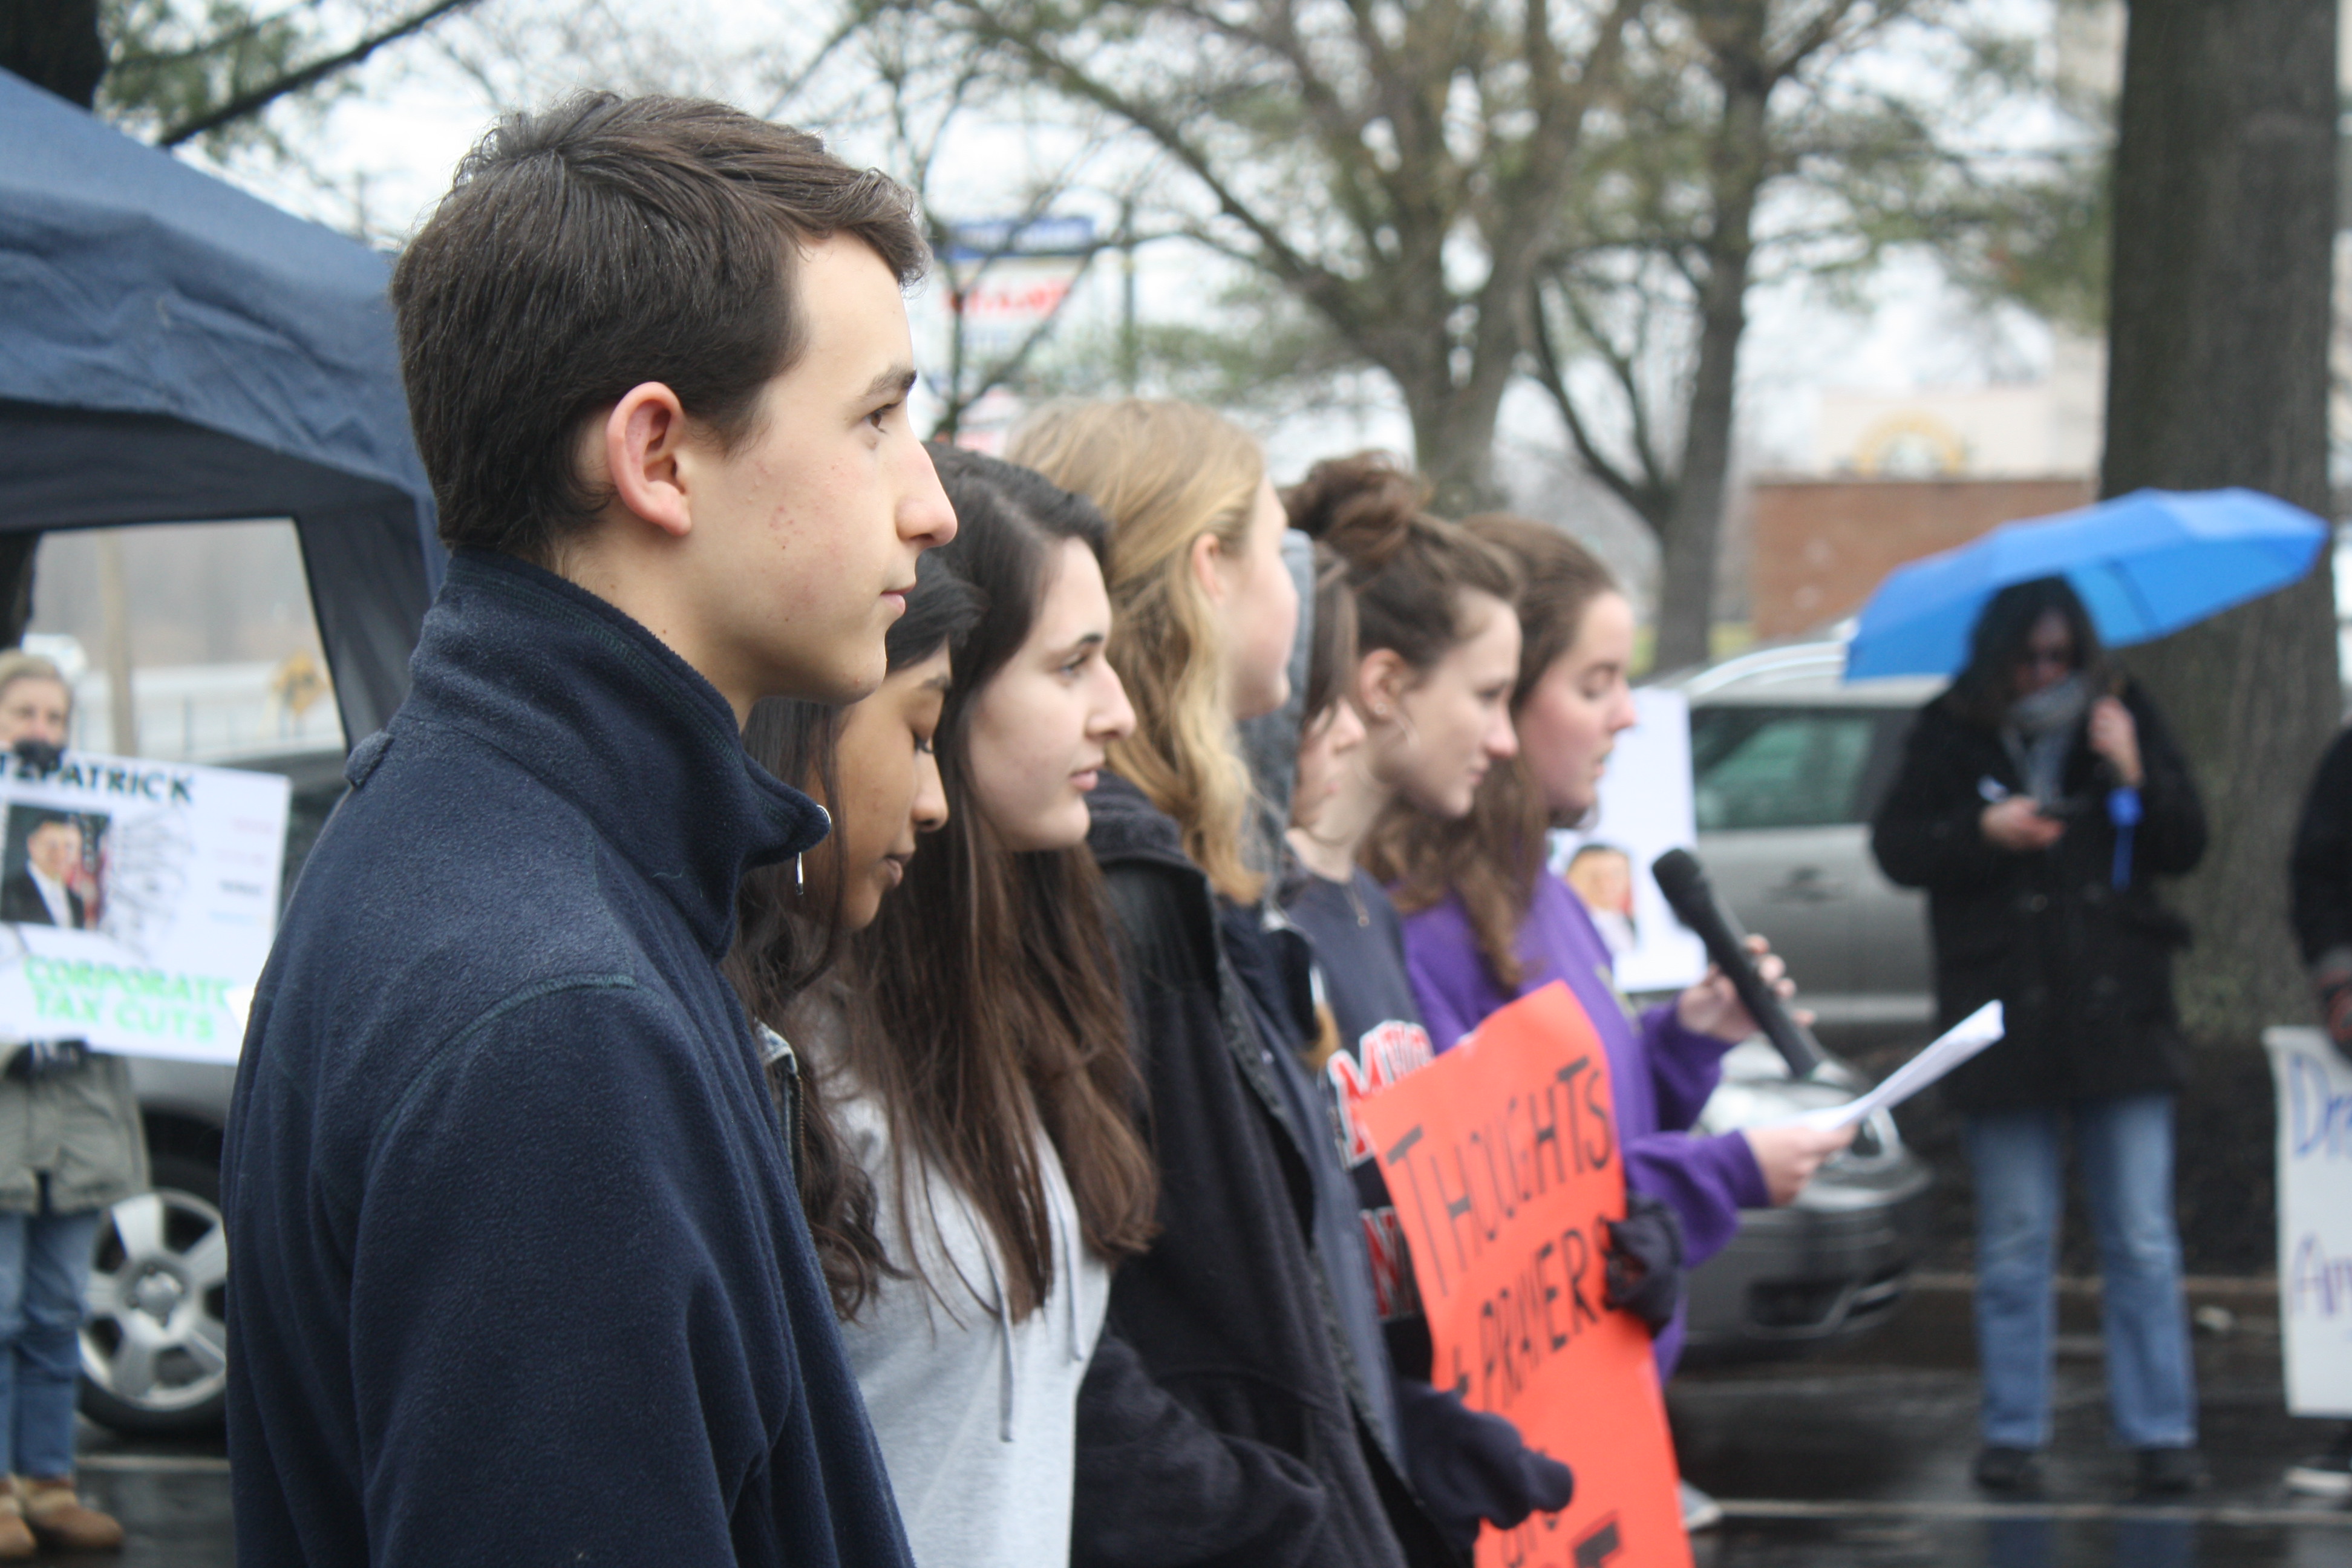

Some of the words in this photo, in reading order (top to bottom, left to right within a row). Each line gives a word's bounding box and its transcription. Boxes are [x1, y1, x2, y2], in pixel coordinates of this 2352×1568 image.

[33, 982, 103, 1024] TAX
[114, 998, 216, 1042] CUTS
[1387, 1054, 1613, 1298] THOUGHTS
